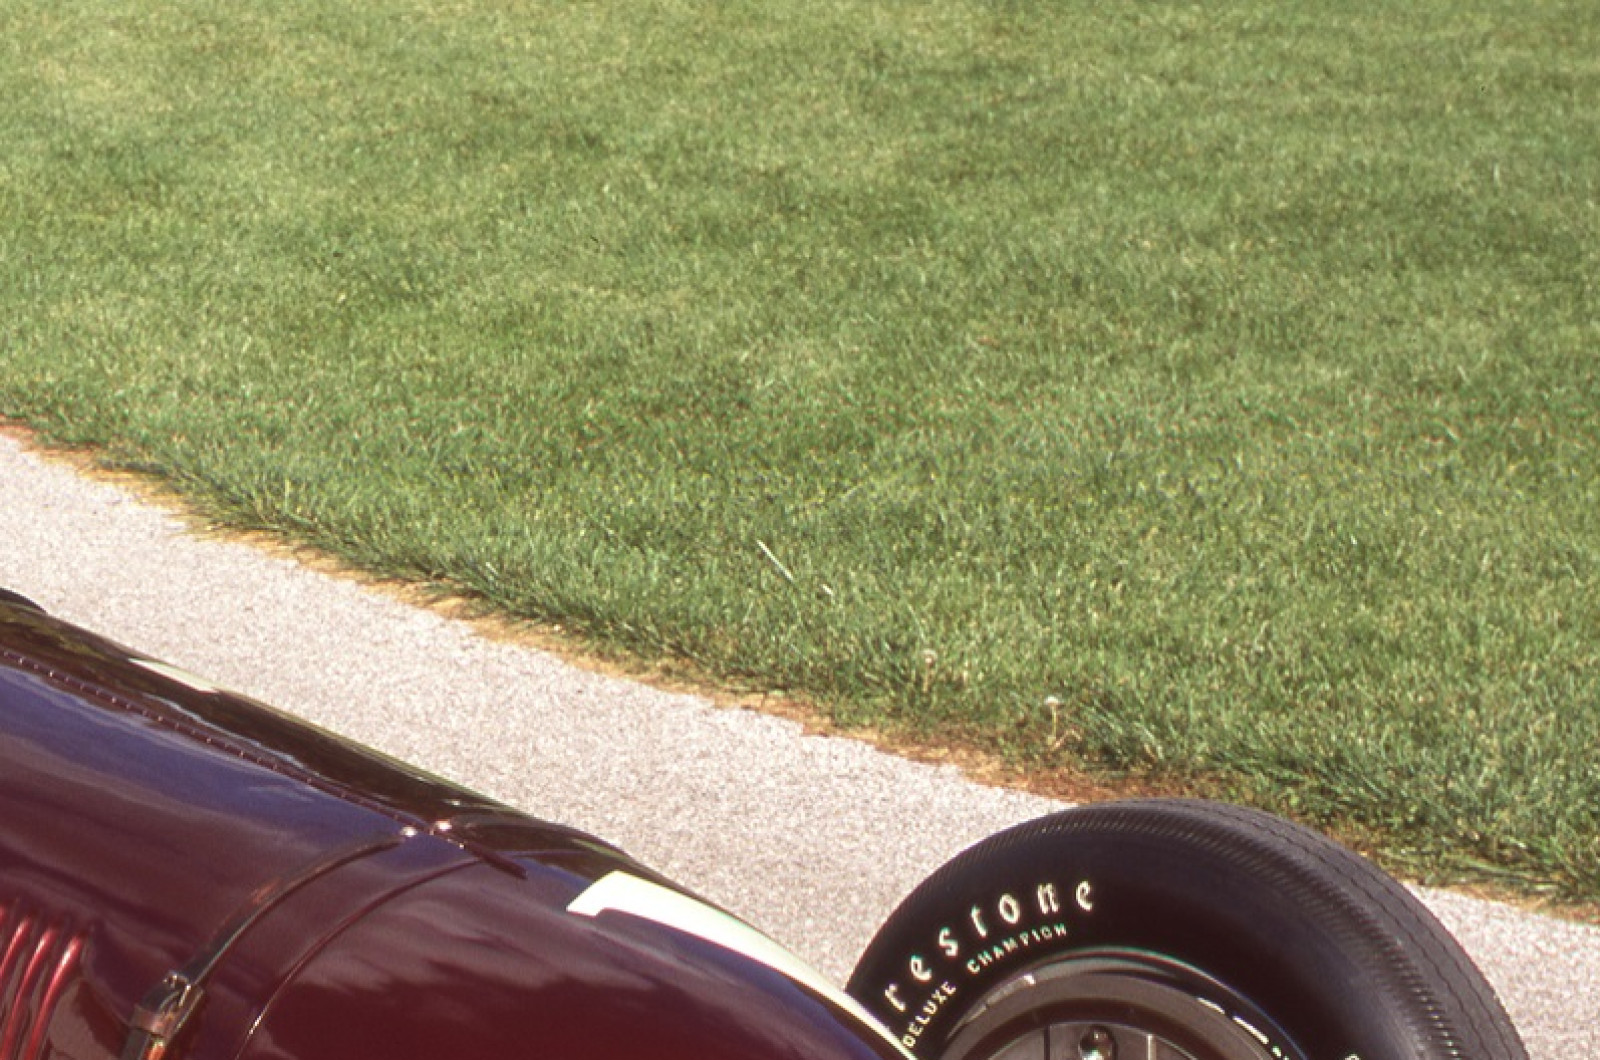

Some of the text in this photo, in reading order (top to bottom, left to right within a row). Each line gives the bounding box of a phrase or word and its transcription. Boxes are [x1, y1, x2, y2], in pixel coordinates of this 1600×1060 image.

[884, 880, 1094, 1013] restone
[902, 922, 1067, 1048] DELUXE CHAMPION
